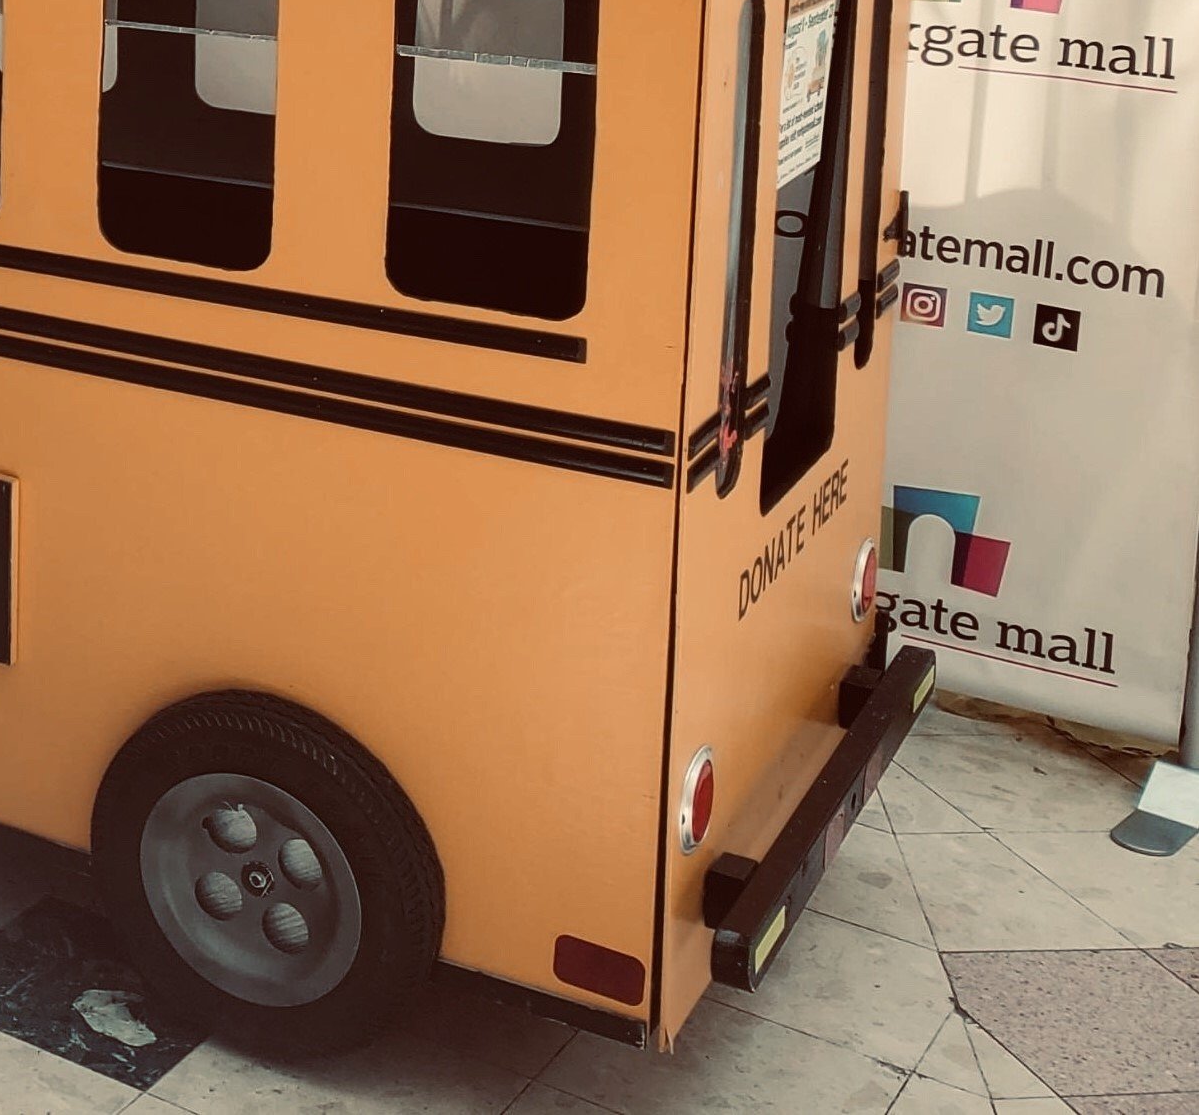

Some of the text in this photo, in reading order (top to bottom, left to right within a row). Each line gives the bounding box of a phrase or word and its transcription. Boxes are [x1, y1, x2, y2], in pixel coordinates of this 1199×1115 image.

[1057, 35, 1176, 81] mall
[738, 458, 849, 621] DONATE HERE
[996, 620, 1116, 675] mall
